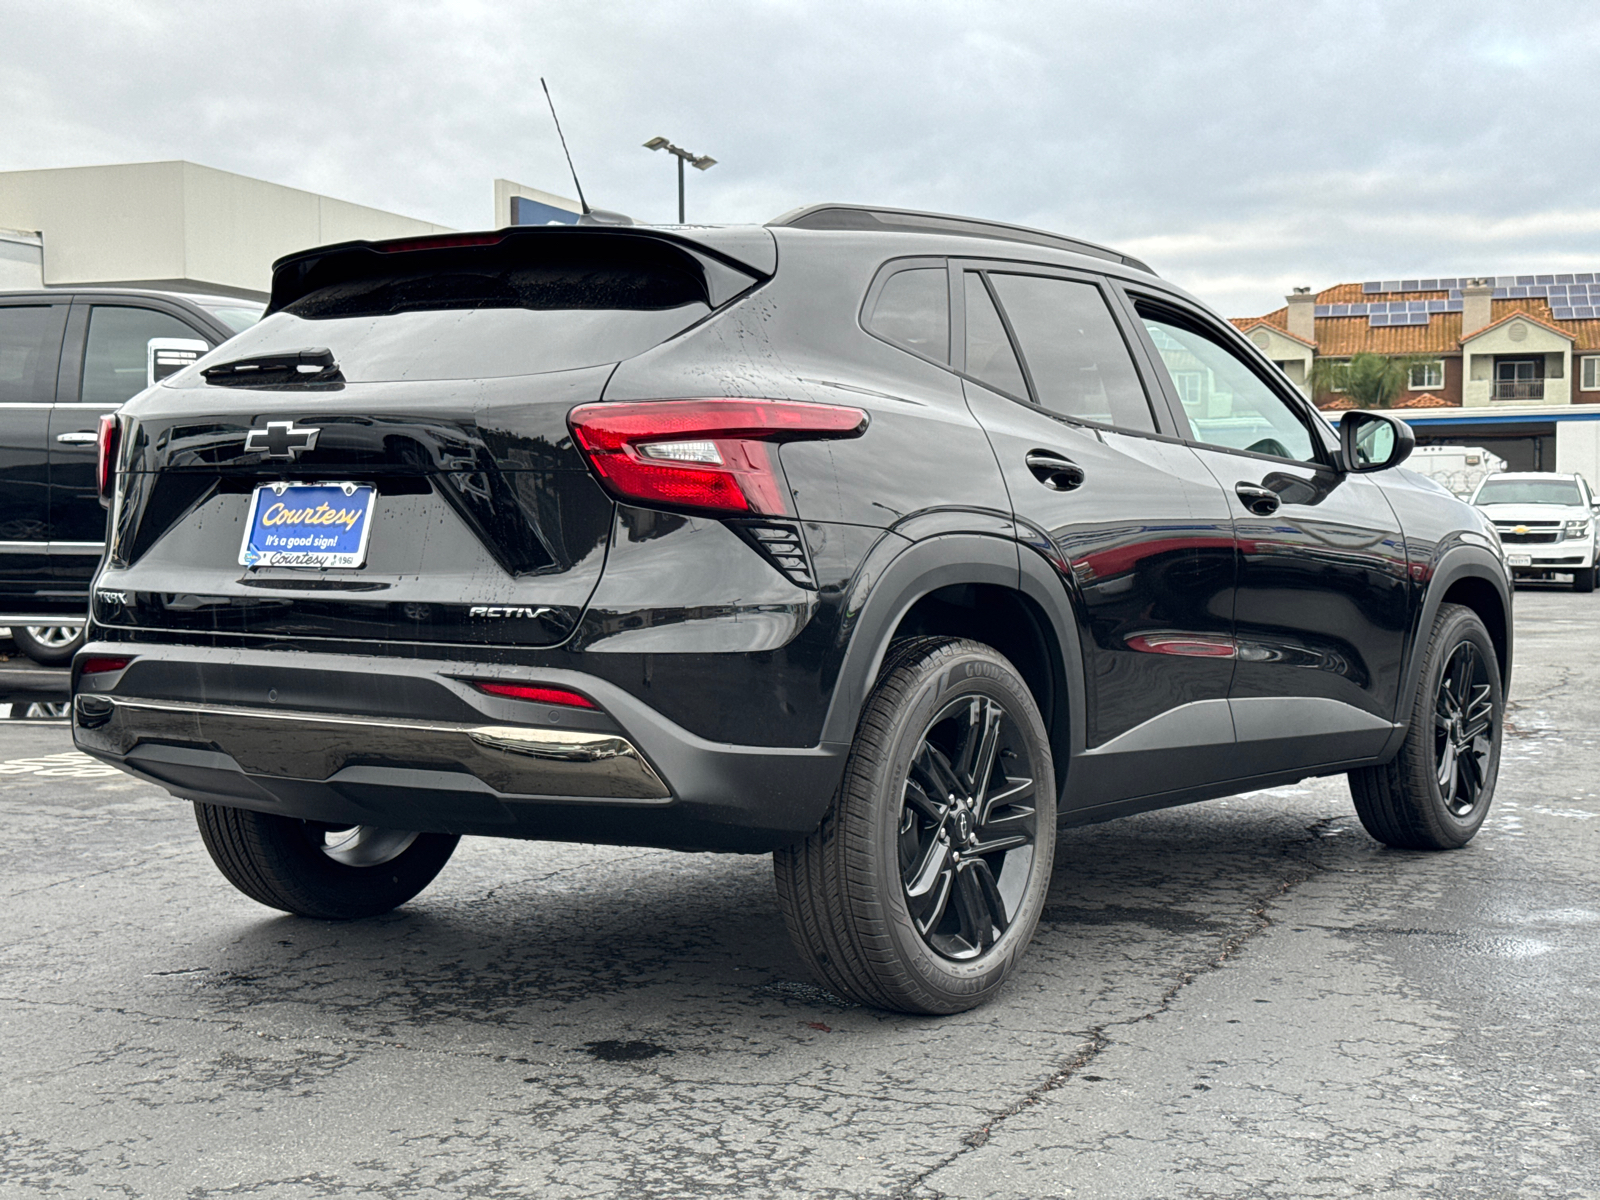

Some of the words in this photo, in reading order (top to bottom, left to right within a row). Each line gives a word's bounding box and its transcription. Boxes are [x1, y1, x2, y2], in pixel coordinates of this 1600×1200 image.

[262, 501, 362, 531] Courtesy
[265, 535, 279, 546] It's
[280, 537, 285, 546] a
[287, 534, 313, 549] good
[313, 535, 338, 549] sign!
[269, 550, 329, 569] Courtesy
[469, 607, 551, 618] ACTIV
